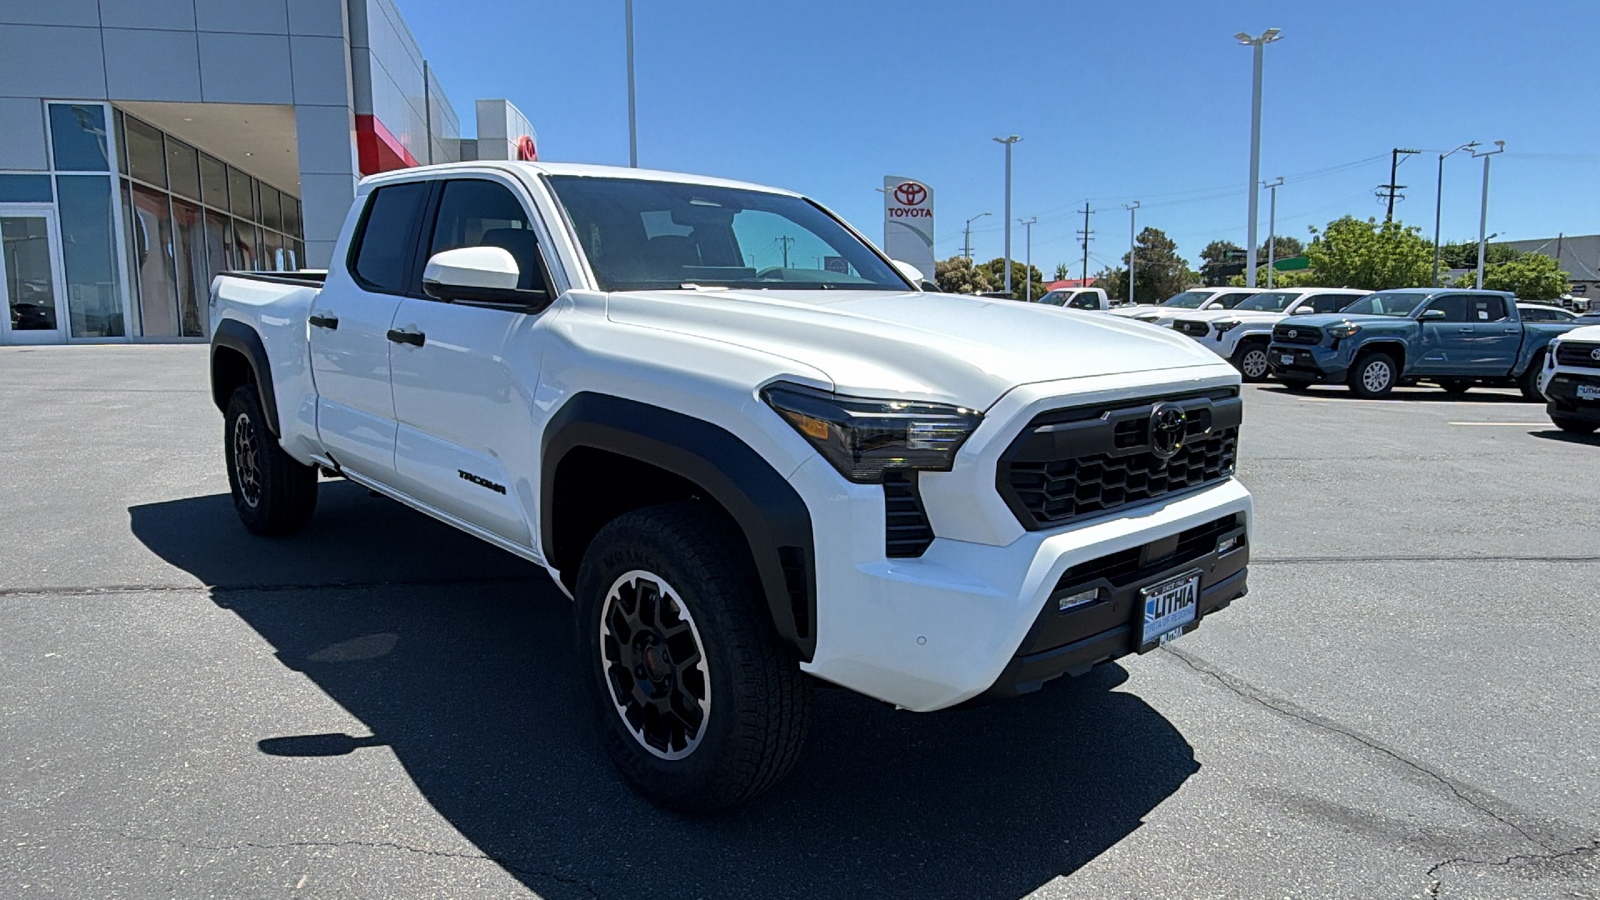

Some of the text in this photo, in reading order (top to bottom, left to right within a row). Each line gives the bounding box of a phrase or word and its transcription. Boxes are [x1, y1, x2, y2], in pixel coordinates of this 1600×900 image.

[888, 207, 933, 218] TOYOTA
[457, 469, 507, 496] TACOMA
[1154, 584, 1194, 620] LITHIA
